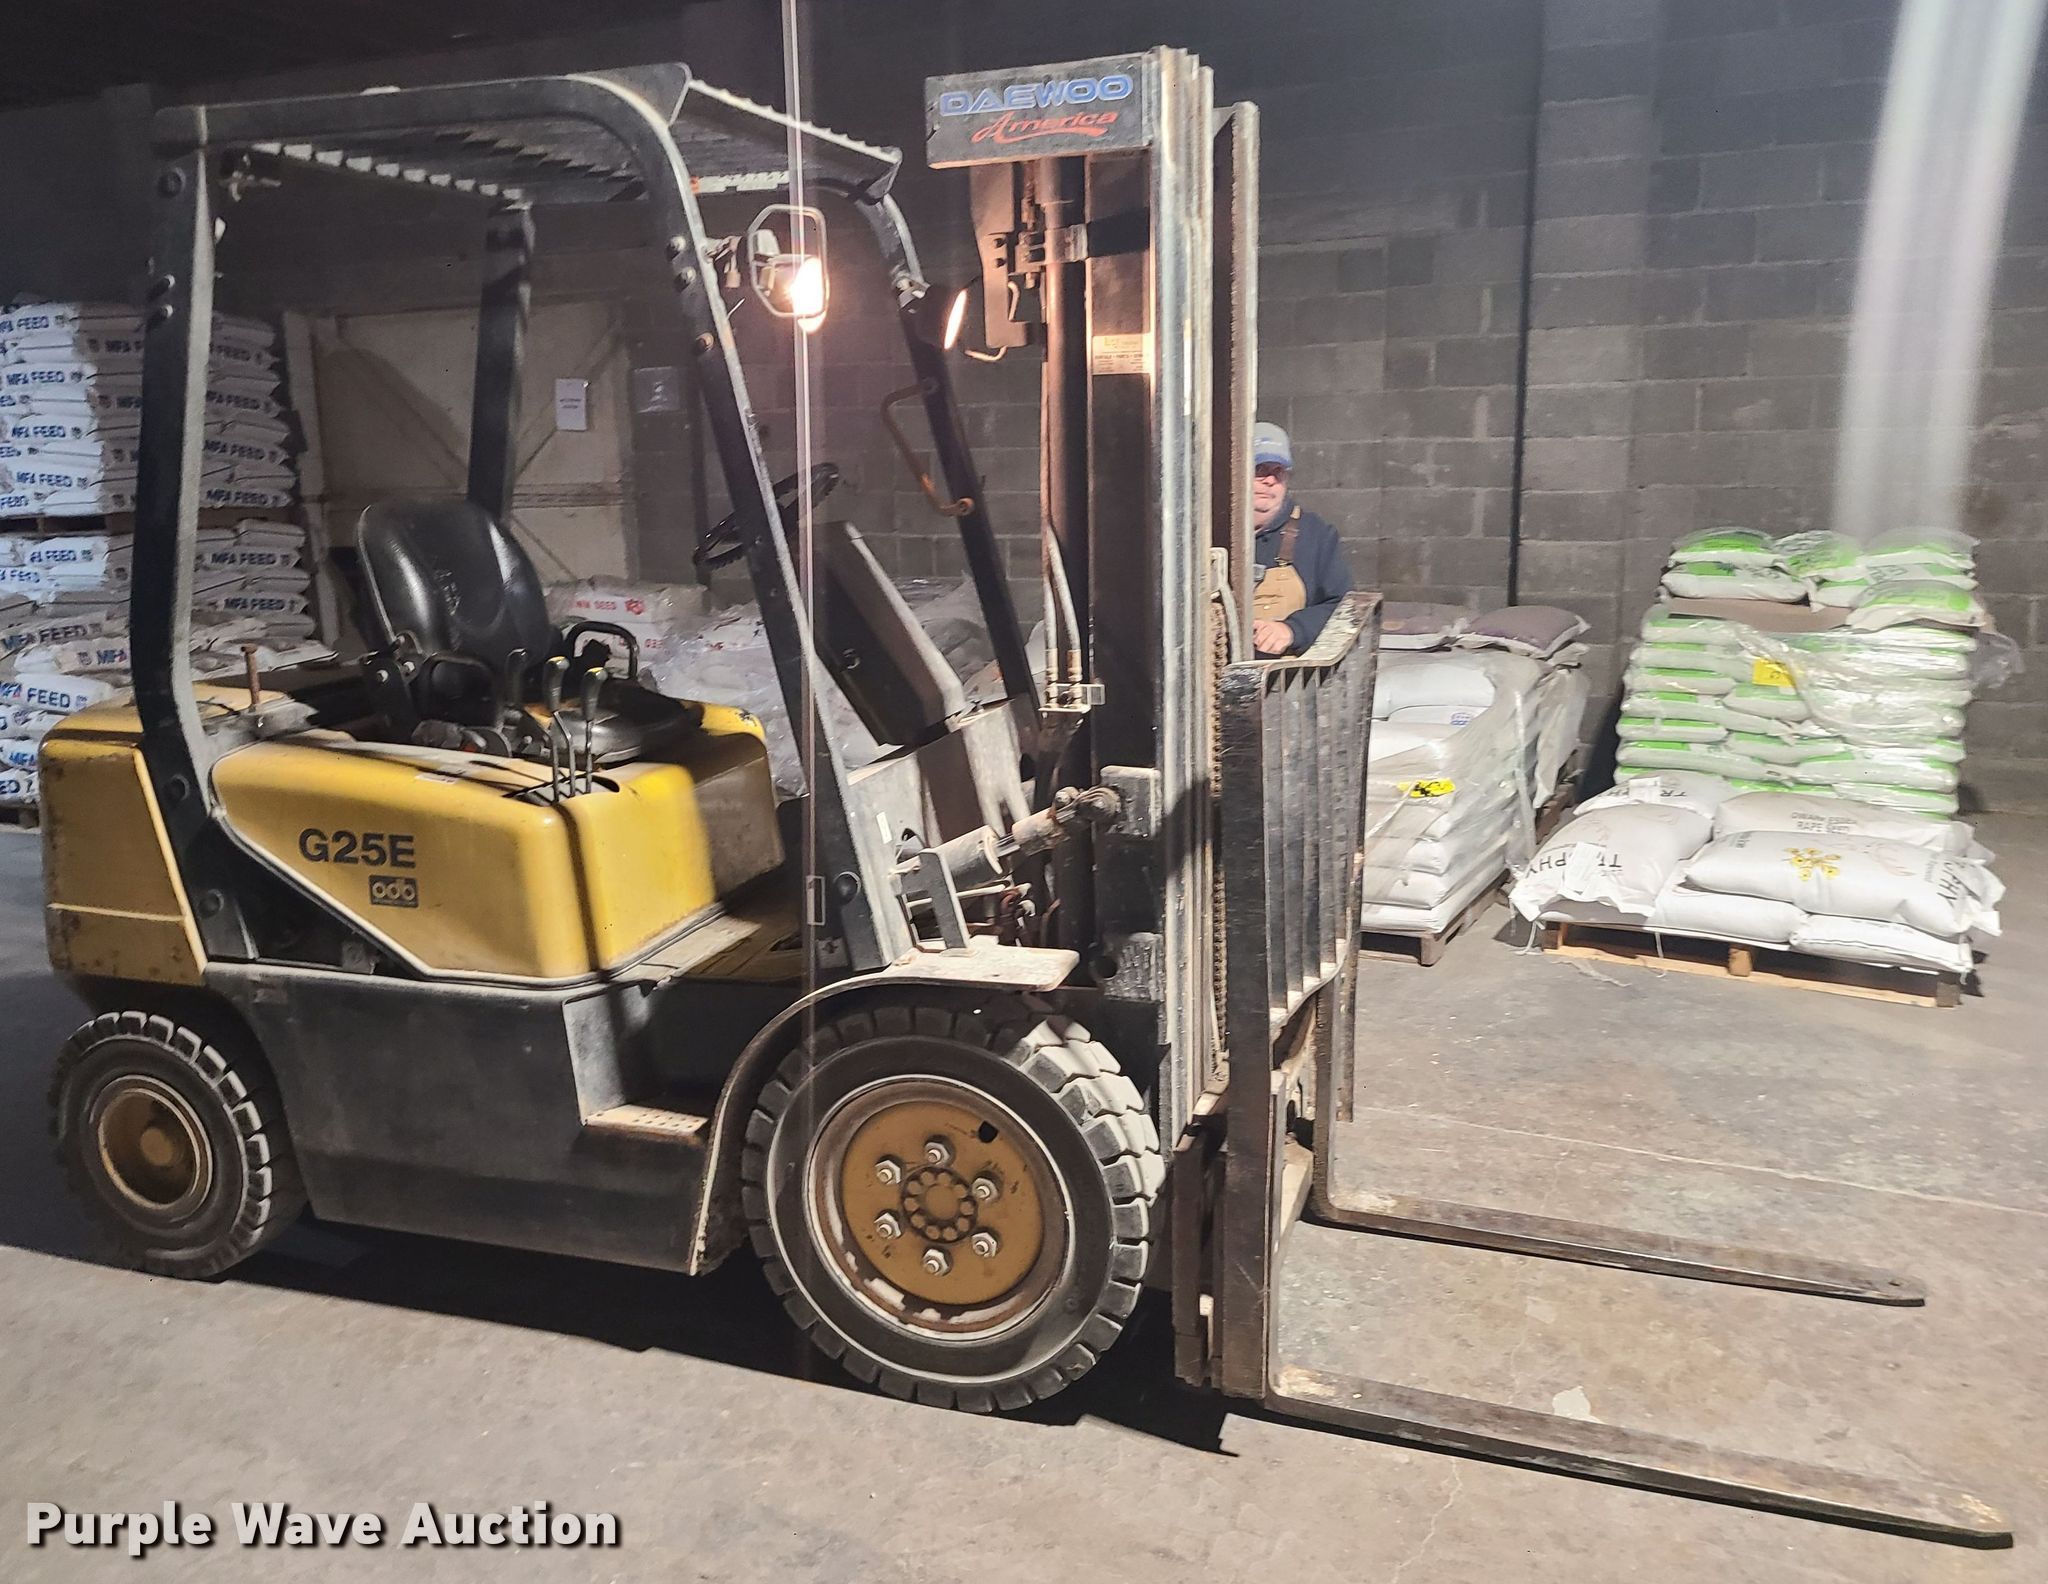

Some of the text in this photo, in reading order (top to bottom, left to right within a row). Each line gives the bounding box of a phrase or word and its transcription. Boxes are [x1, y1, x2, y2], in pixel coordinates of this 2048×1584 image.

[939, 74, 1134, 116] DAEWOO
[971, 111, 1118, 144] America
[16, 316, 50, 330] FEED
[6, 371, 65, 386] MFA FEED
[11, 425, 66, 438] MFA FEED
[229, 443, 266, 460] FEED
[16, 471, 73, 488] MFA FEED
[206, 489, 269, 505] MFA FEED
[45, 549, 78, 562] FEED
[211, 553, 277, 565] MFA FEED
[223, 597, 286, 611] MFA FEED
[2, 623, 88, 651] MFA FEED
[96, 649, 128, 665] MFA
[26, 687, 71, 709] FEED
[298, 827, 416, 869] G25E
